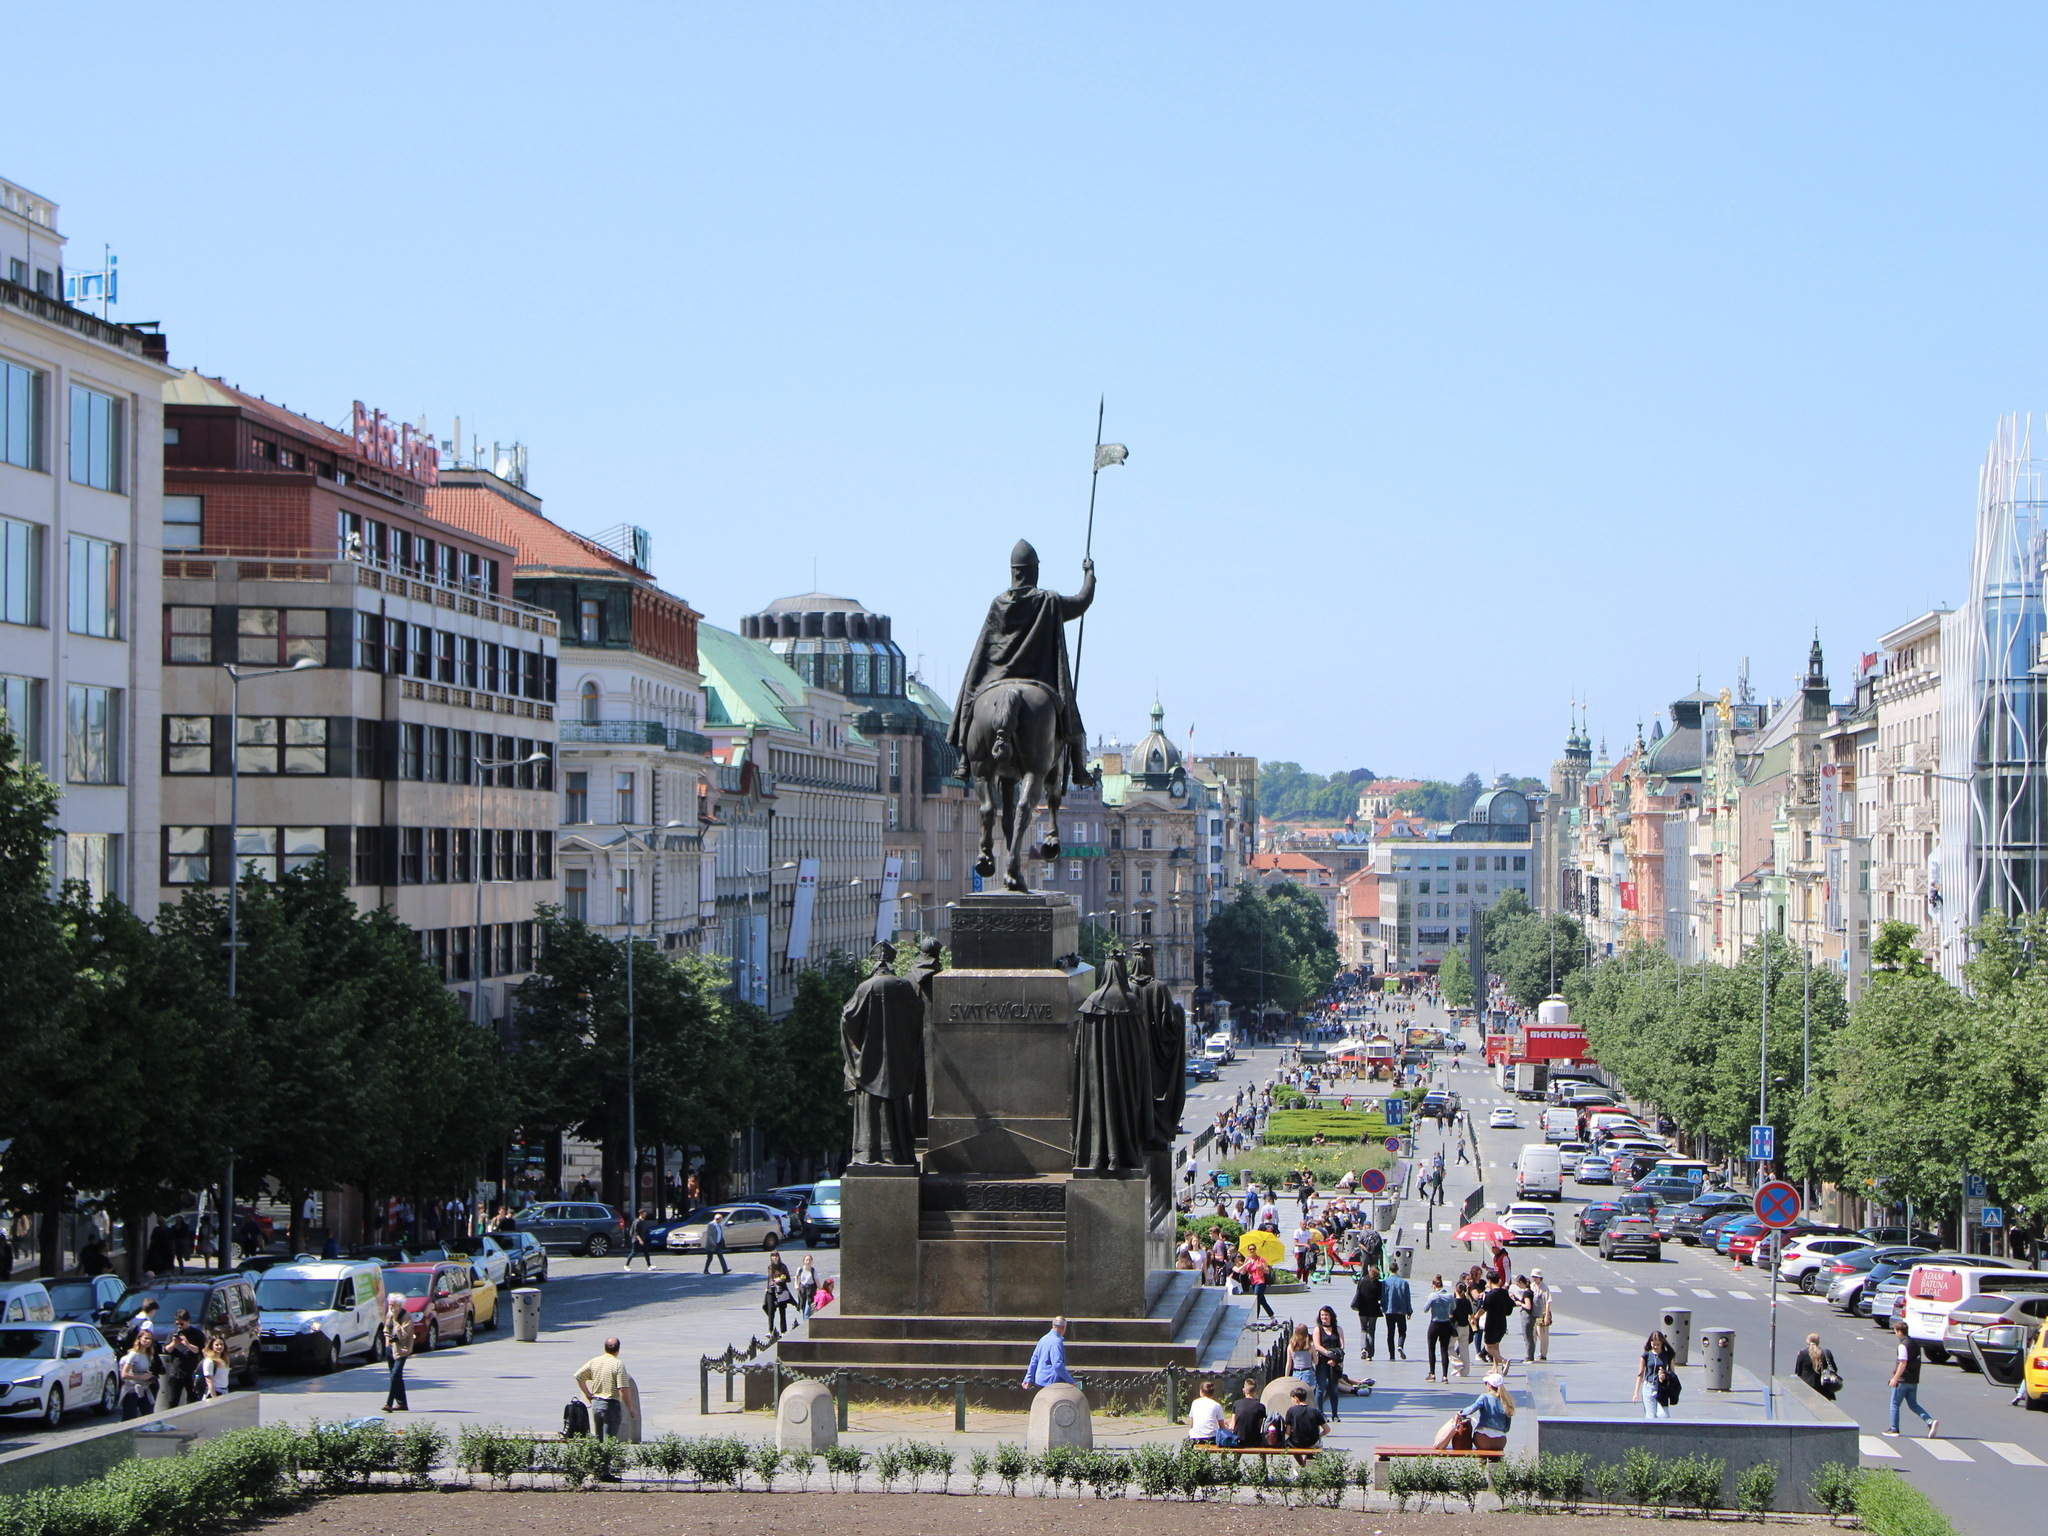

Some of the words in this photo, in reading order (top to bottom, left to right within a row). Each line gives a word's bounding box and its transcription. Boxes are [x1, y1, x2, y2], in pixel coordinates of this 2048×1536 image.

[1824, 783, 1834, 844] RAMADA
[1971, 1174, 1982, 1190] P
[1922, 1271, 1945, 1281] ADAM
[1920, 1279, 1949, 1291] BATUNA
